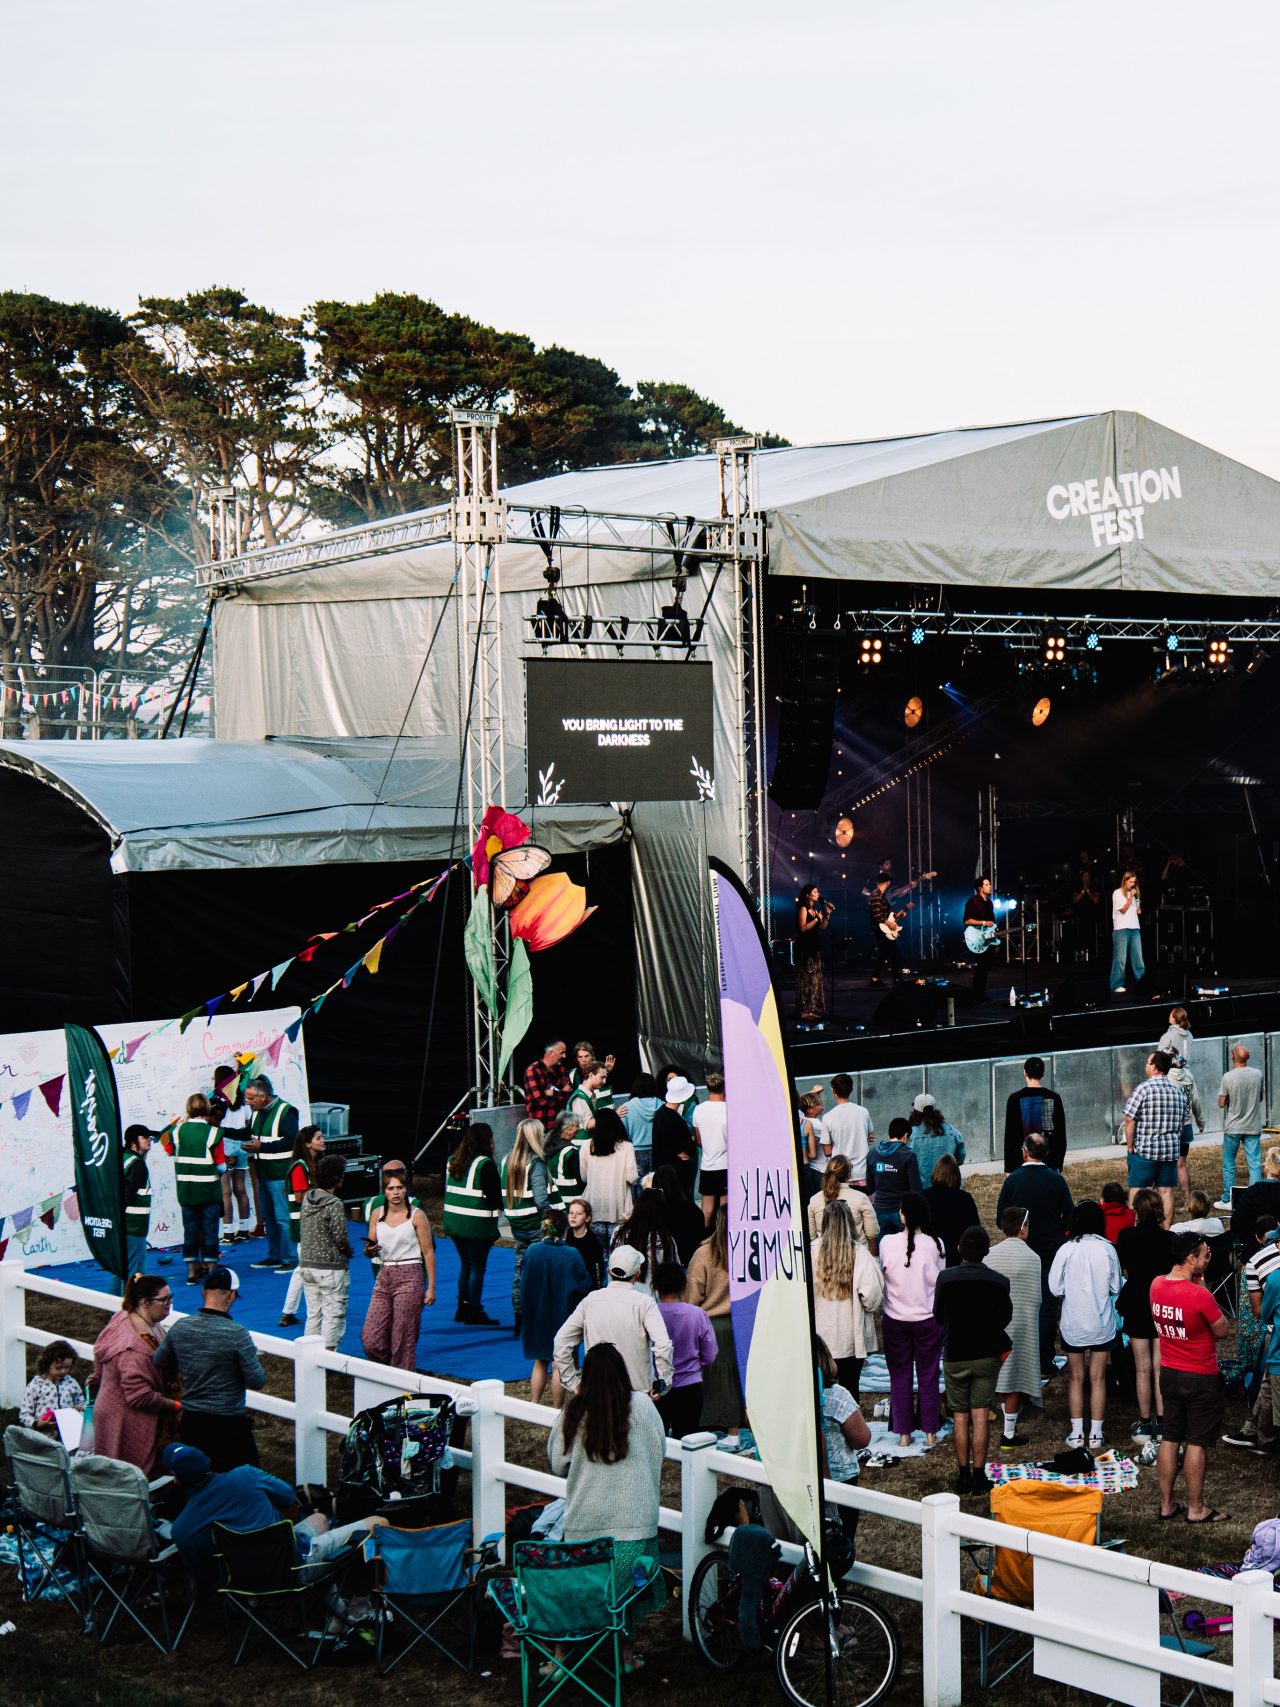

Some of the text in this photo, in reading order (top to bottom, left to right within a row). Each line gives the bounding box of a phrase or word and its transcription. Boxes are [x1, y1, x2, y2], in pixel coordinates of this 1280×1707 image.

[466, 413, 493, 421] PROLYTE
[1046, 466, 1182, 520] CREATION
[1090, 506, 1145, 548] FEST
[562, 719, 684, 731] YOU BRING LIGHT TO THE
[598, 733, 651, 746] DARKNESS
[1152, 1302, 1183, 1321] 49 55 N
[1163, 1324, 1176, 1337] 19
[1176, 1326, 1186, 1338] W
